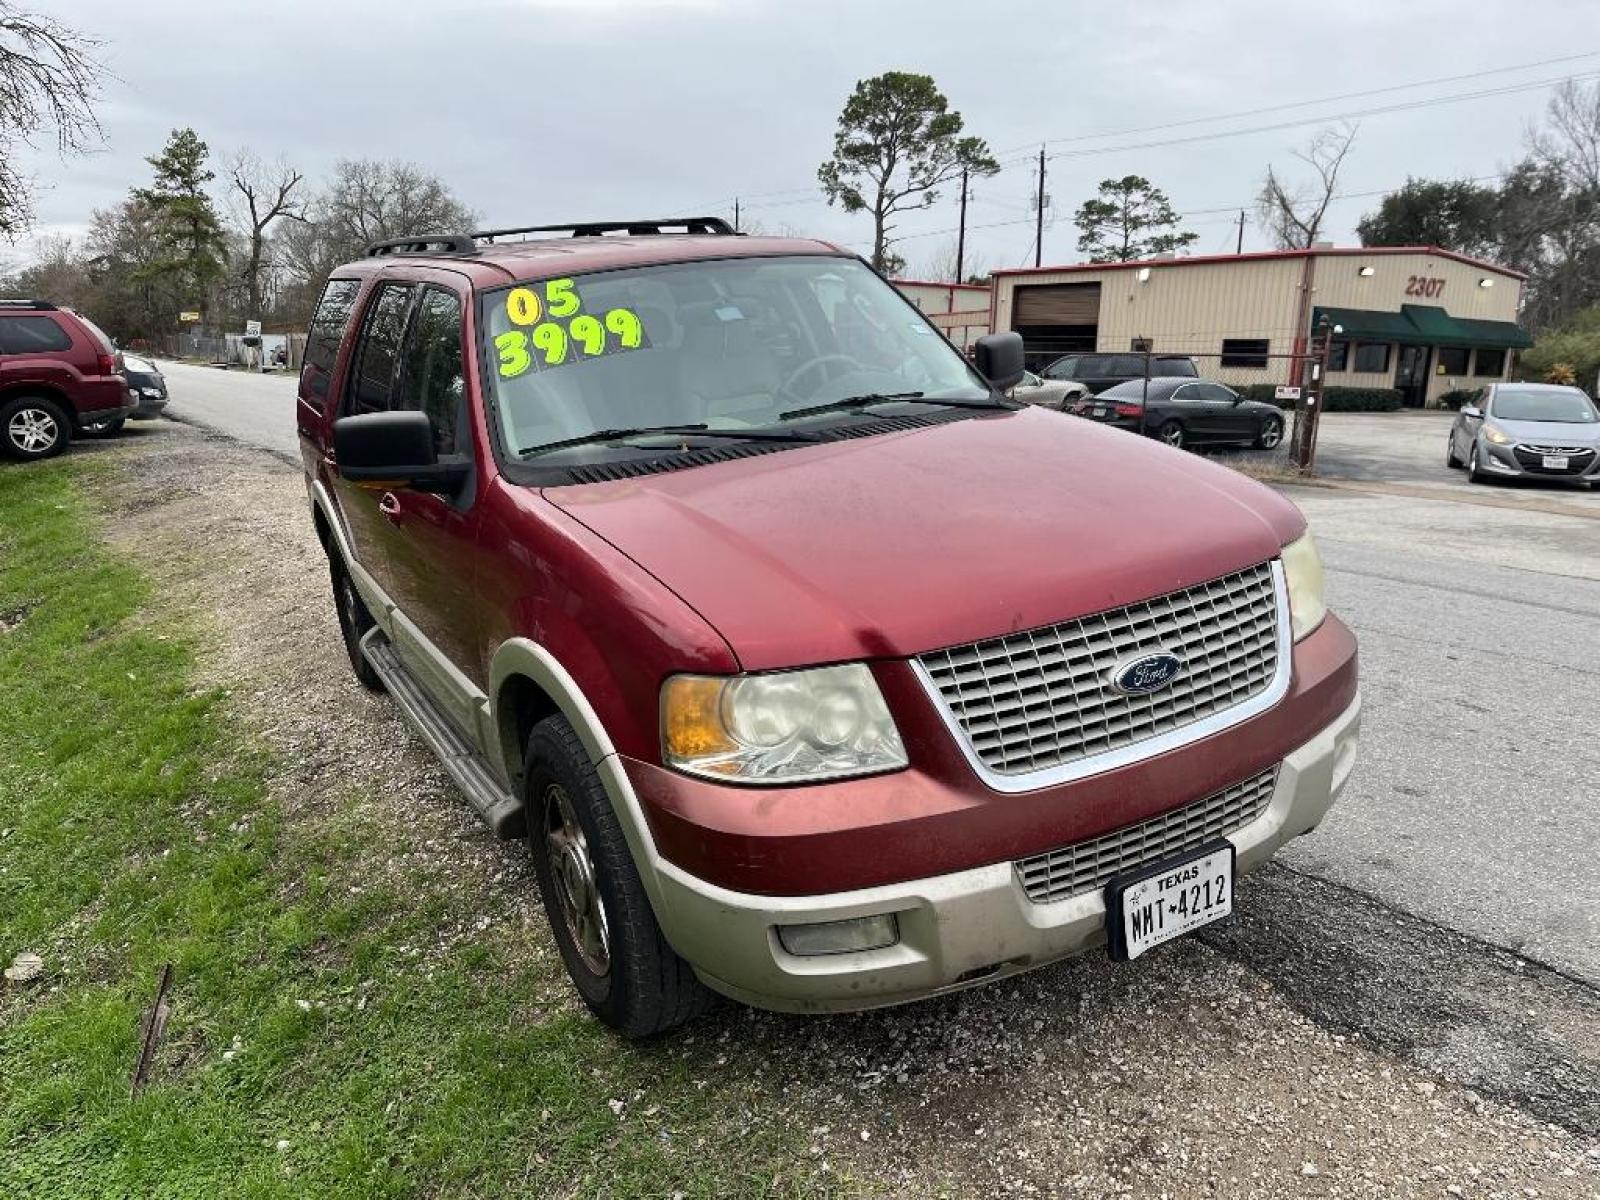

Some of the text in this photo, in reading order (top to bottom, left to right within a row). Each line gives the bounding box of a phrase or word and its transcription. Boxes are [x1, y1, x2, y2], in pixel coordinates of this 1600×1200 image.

[1405, 275, 1446, 298] 2307
[507, 278, 581, 326] 05
[495, 308, 642, 378] 3999
[1134, 661, 1169, 687] Ford
[1157, 865, 1200, 892] TEXAS
